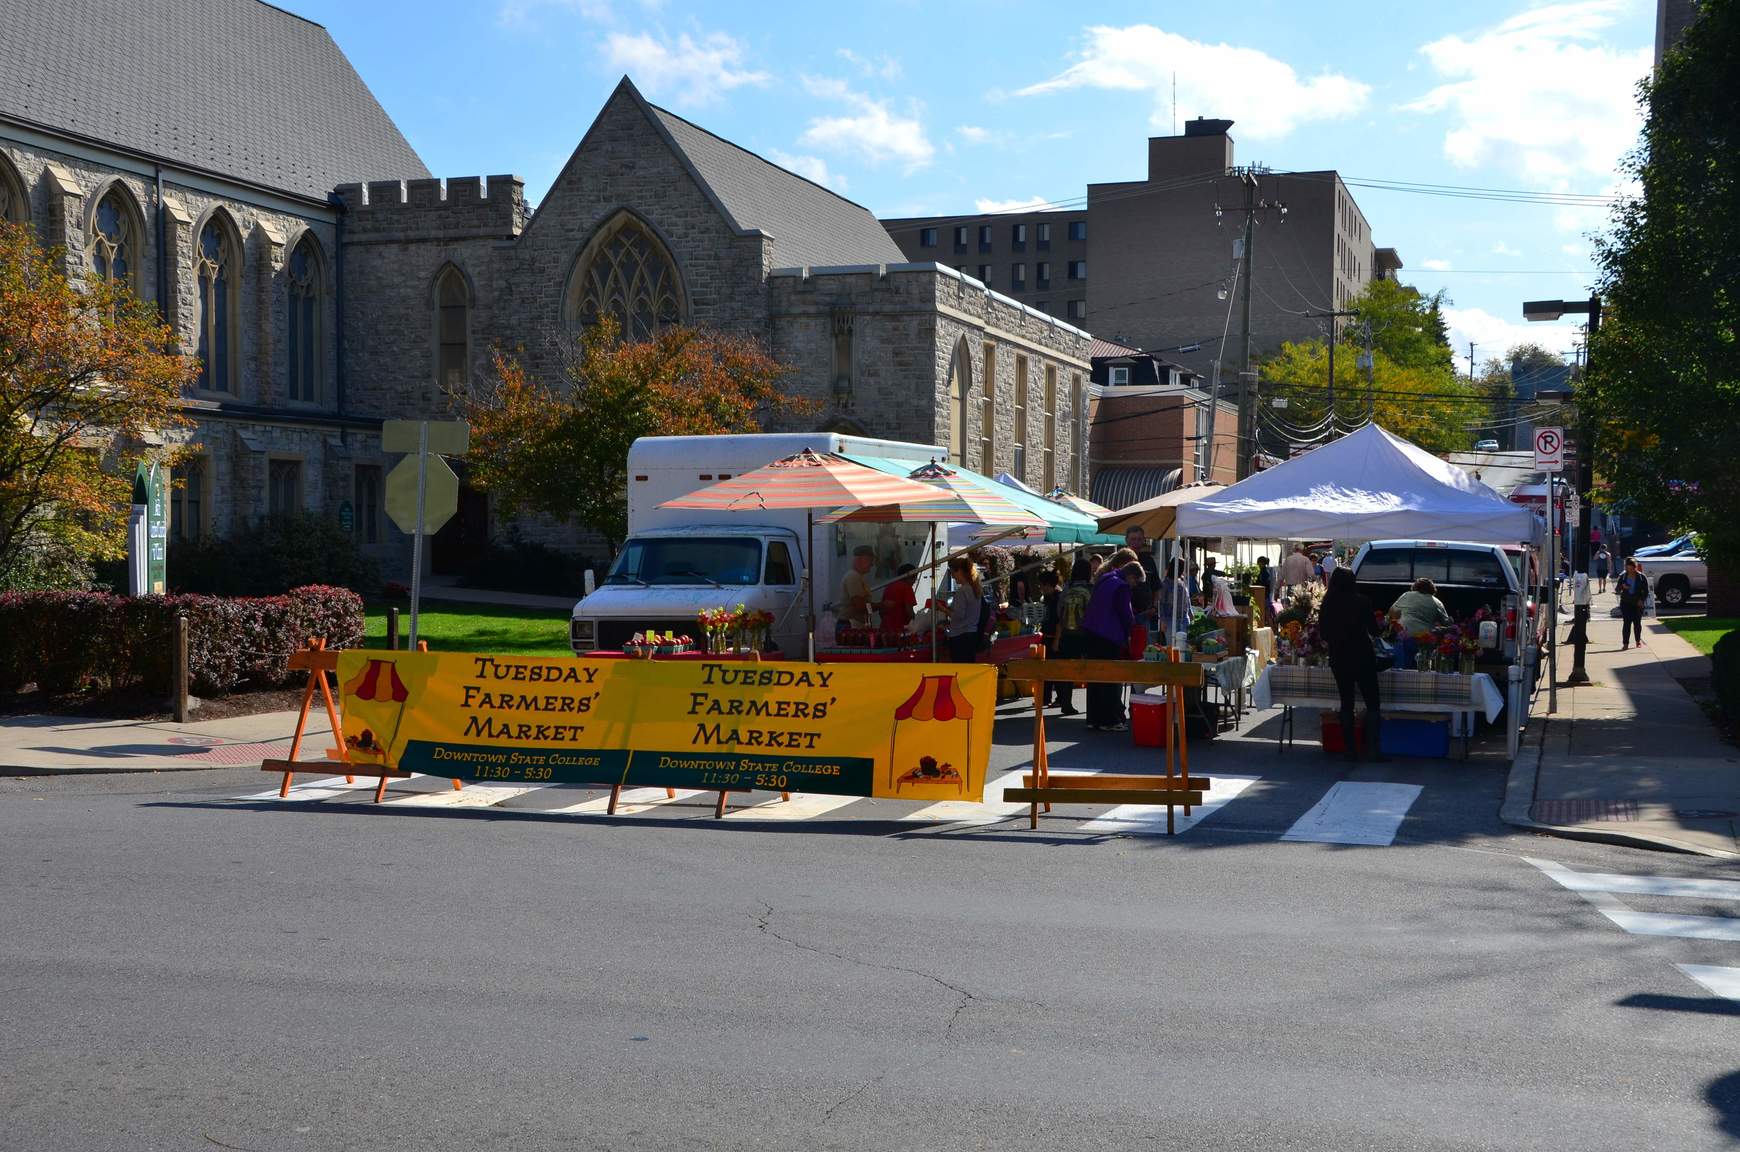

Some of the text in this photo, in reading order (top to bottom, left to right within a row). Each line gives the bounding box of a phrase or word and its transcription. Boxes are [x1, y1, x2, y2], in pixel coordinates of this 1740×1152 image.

[474, 657, 599, 684] TUESDAY
[701, 663, 833, 688] TUESDAY
[460, 685, 600, 714] FARMERS'
[687, 692, 838, 720] FARMERS'
[463, 715, 585, 741] MARKET
[691, 723, 822, 749] MARKET
[432, 747, 601, 766] DOWNTOWN STATE COLLEGE
[658, 756, 841, 776] DOWNTOWN STATE COLLEGE
[474, 765, 510, 778] 11:30
[524, 767, 552, 779] 5:30
[701, 772, 740, 784] 11:30
[755, 774, 788, 788] 5:30
